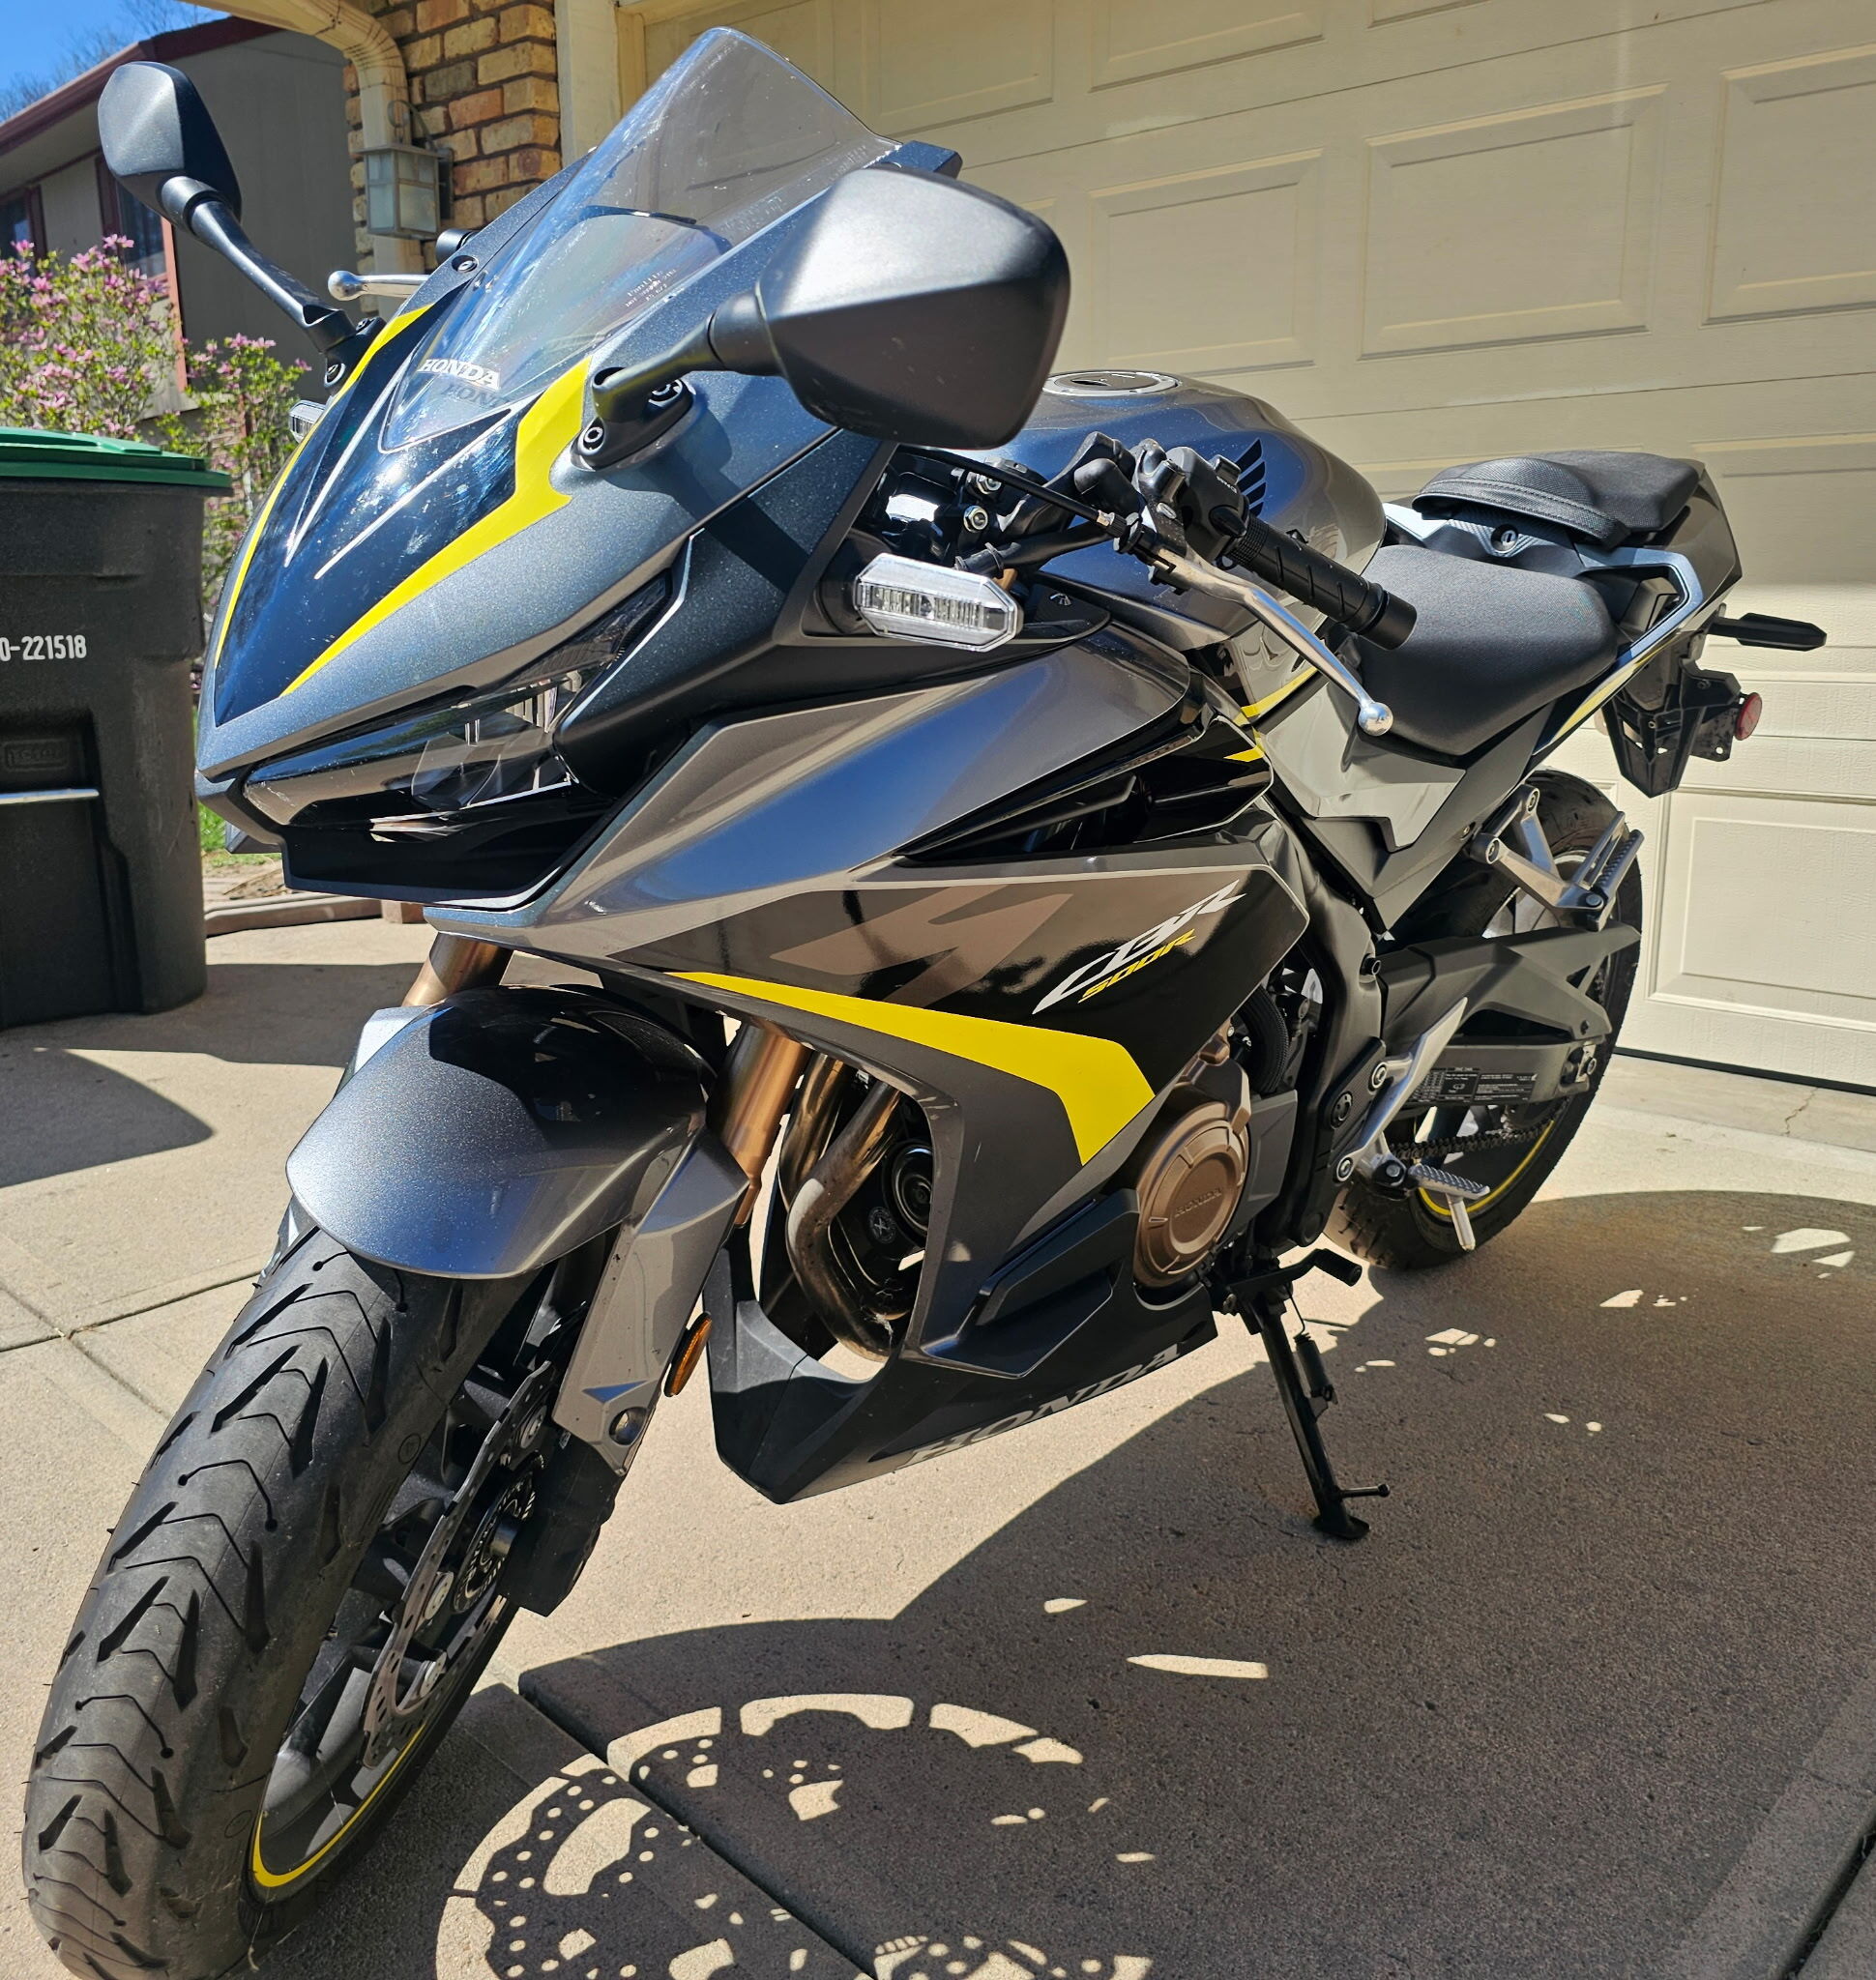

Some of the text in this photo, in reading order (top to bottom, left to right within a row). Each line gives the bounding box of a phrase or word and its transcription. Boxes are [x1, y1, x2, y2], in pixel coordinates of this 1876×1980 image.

[417, 358, 500, 391] HONDA
[1032, 879, 1246, 1015] CBR
[1077, 928, 1196, 1004] 500R
